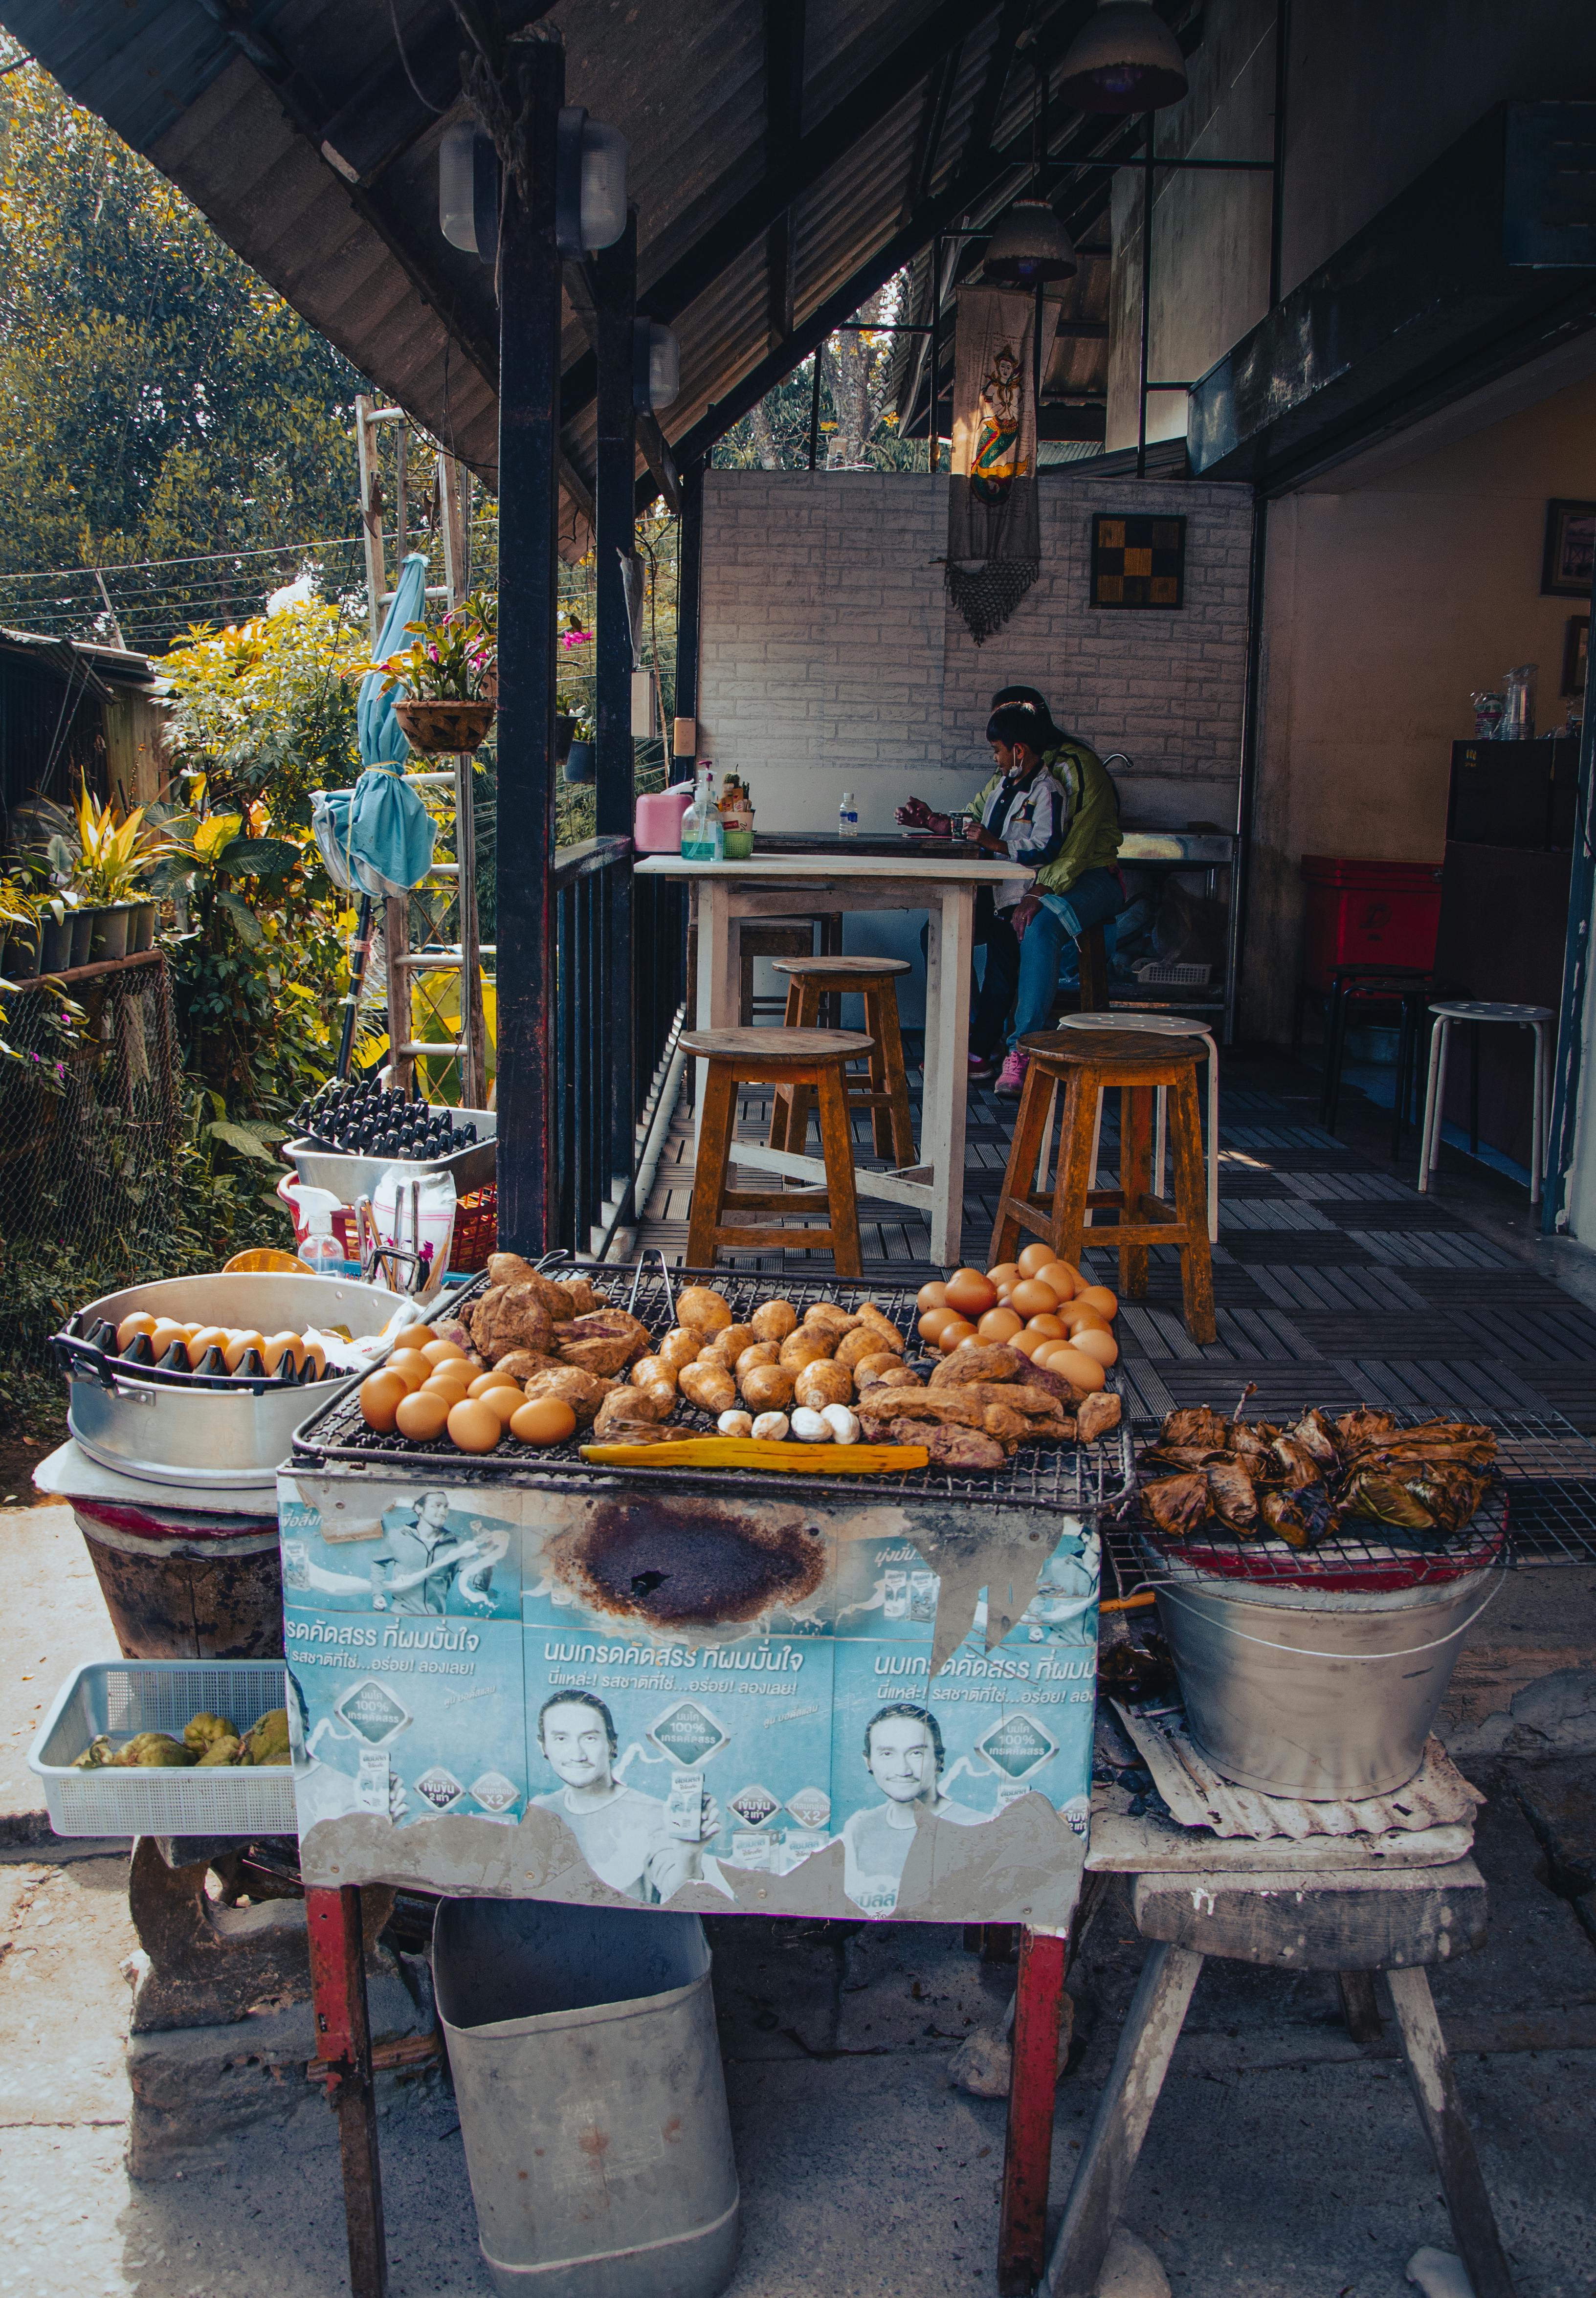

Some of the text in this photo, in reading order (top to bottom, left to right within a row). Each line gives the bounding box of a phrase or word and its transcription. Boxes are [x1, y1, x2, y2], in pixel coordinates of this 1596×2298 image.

[383, 1617, 479, 1652] ที่ผมมั่นใจ
[545, 1641, 697, 1668] นมเกรดคัดสรร
[419, 1660, 474, 1676] ลองเลย!
[874, 1653, 1030, 1679] นมเกดคัดสรร
[738, 1681, 797, 1695] ลองเลย!
[361, 1690, 382, 1700] นมโค
[355, 1700, 389, 1713] 100%
[677, 1711, 699, 1722] นมโค
[670, 1722, 706, 1734] 100%
[1007, 1723, 1030, 1733] นมโค
[999, 1735, 1036, 1745] 100%
